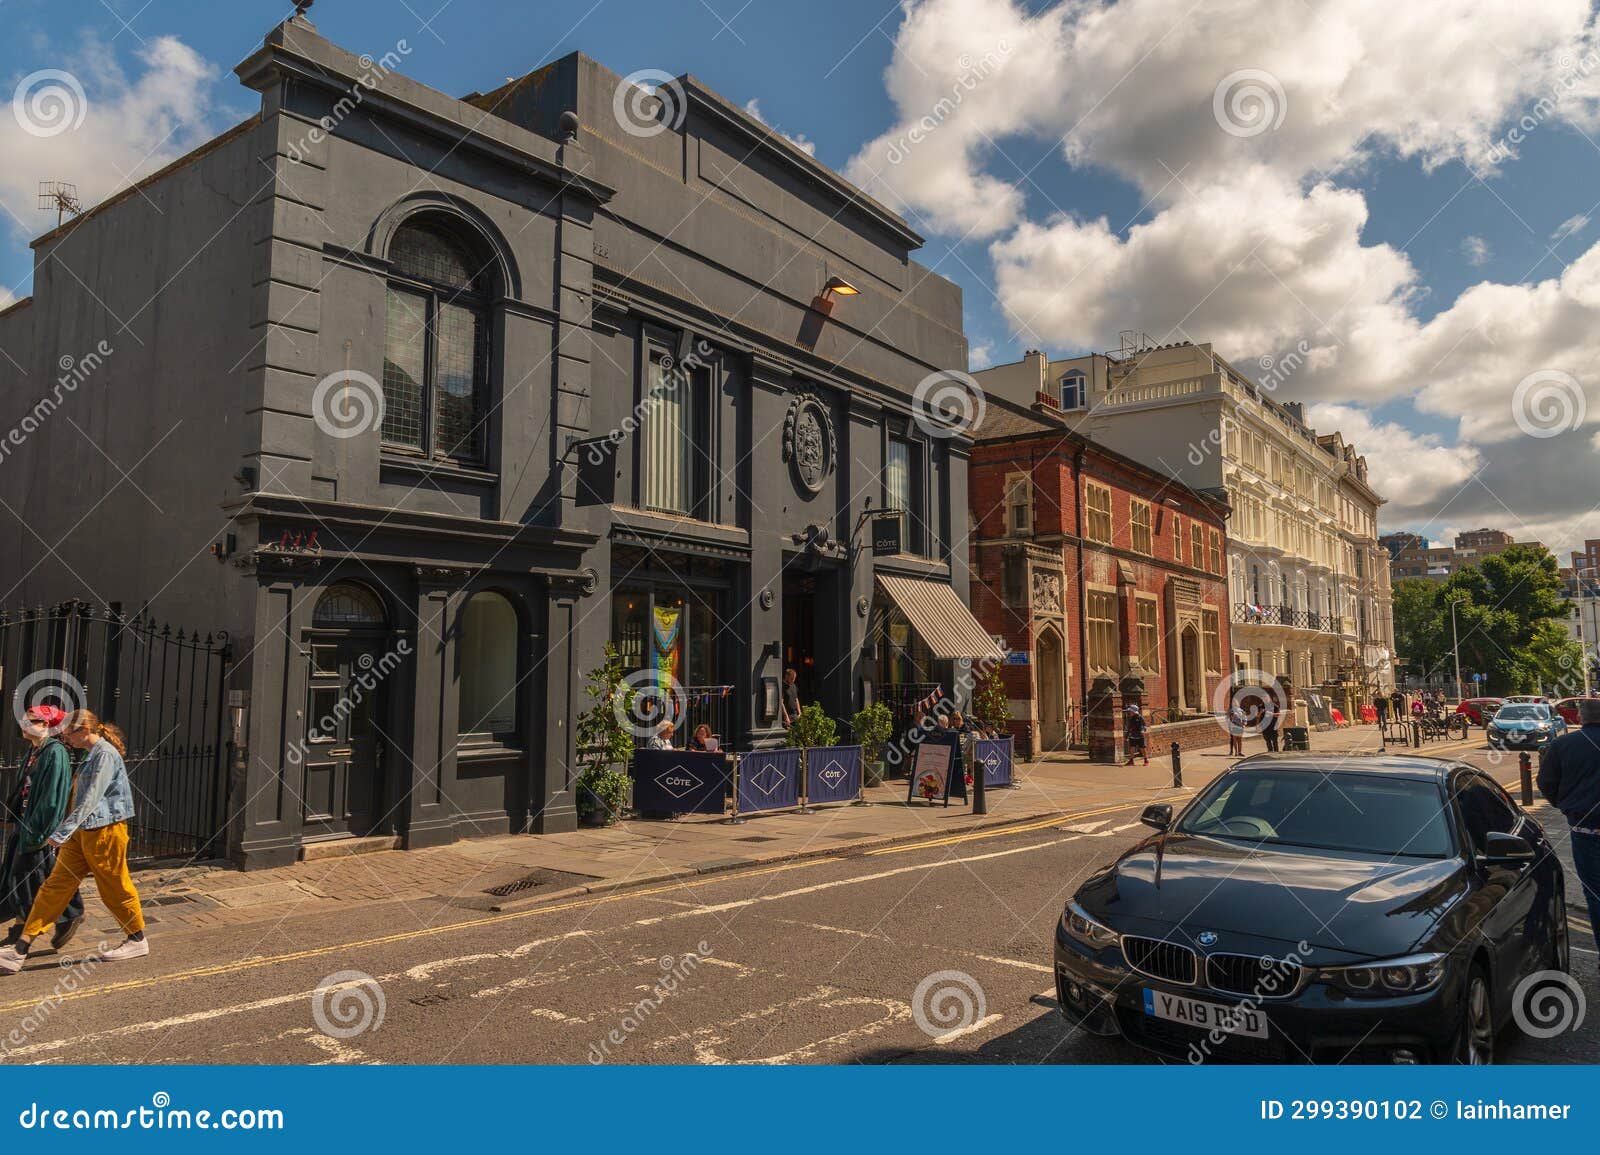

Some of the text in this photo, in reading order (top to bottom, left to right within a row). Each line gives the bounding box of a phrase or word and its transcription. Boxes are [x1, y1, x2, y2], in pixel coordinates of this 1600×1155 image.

[825, 770, 840, 778] CÔTE
[665, 776, 691, 786] CÔTE
[1161, 995, 1207, 1023] YA19
